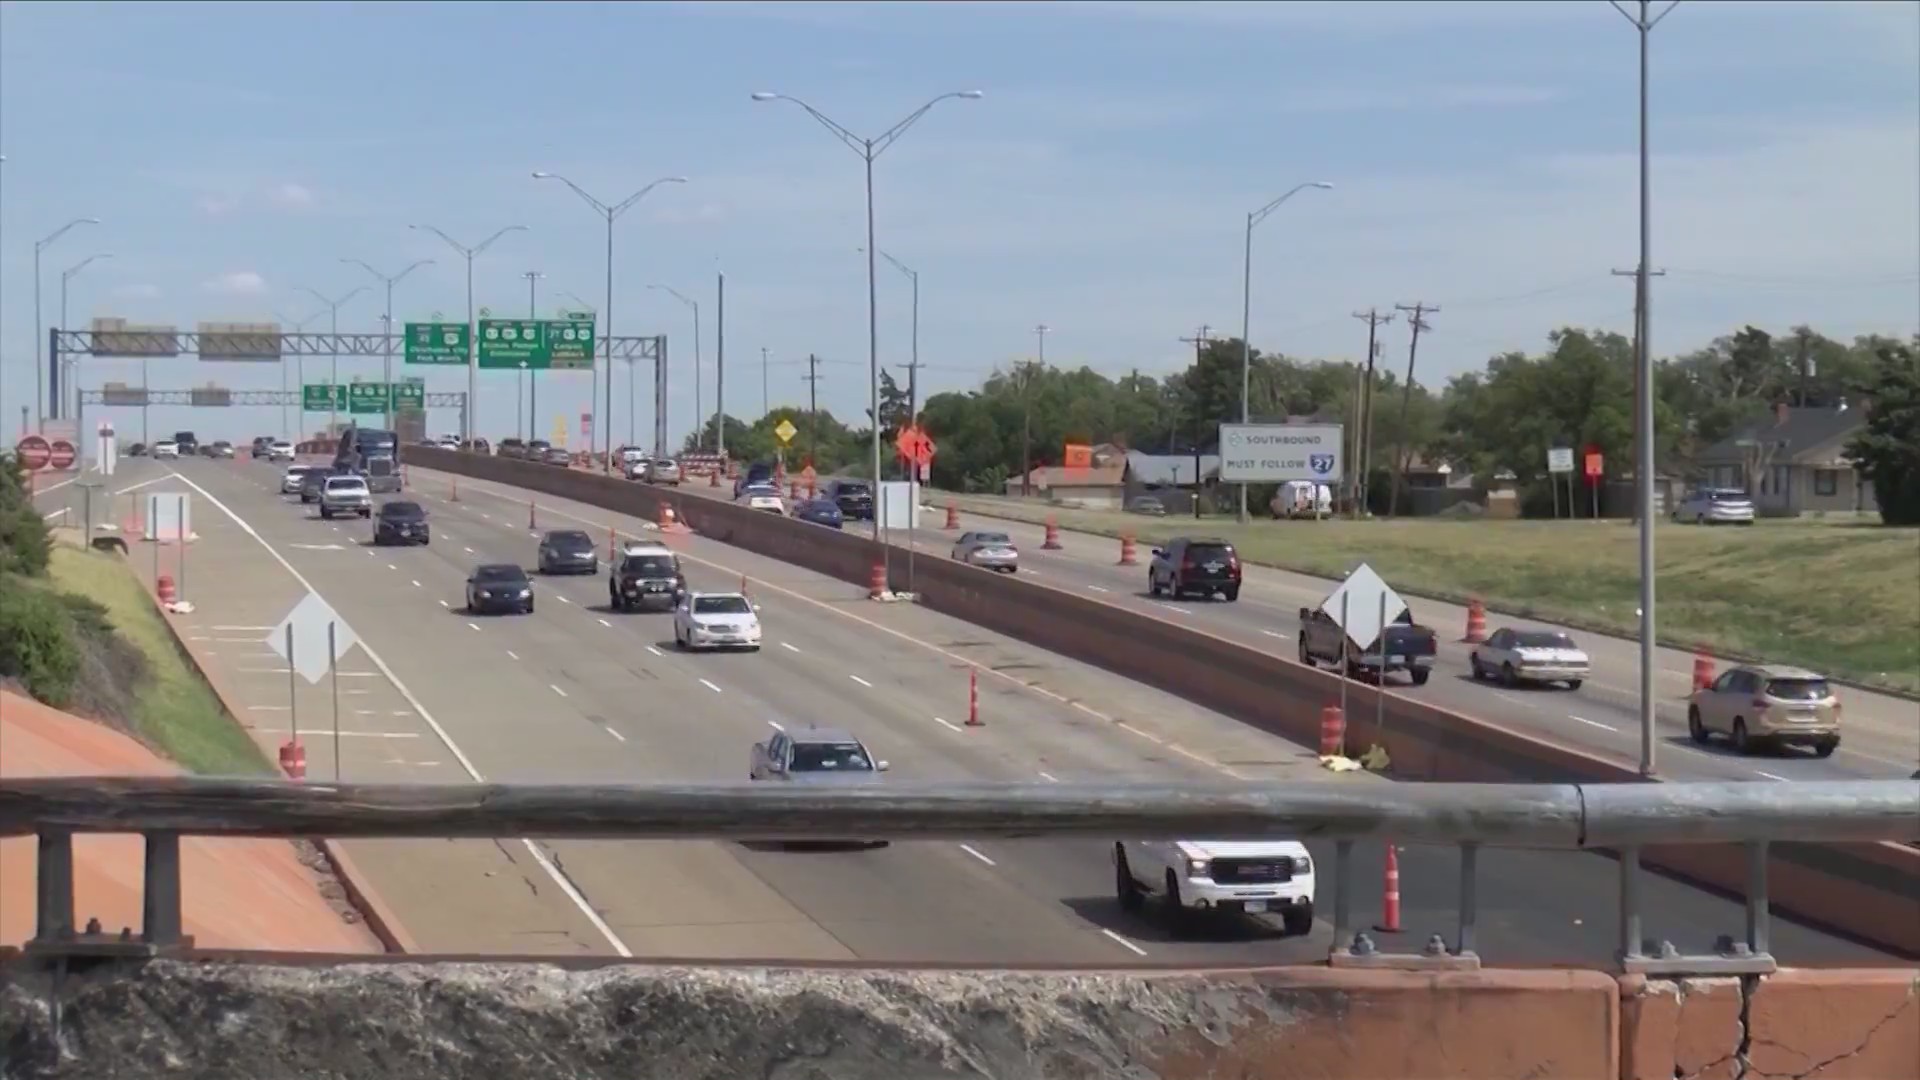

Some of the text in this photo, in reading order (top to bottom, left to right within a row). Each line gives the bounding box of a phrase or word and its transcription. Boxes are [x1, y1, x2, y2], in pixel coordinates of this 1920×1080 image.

[1246, 435, 1322, 445] SOUTHBOUND
[1227, 459, 1331, 471] MUST FOLLOW 27
